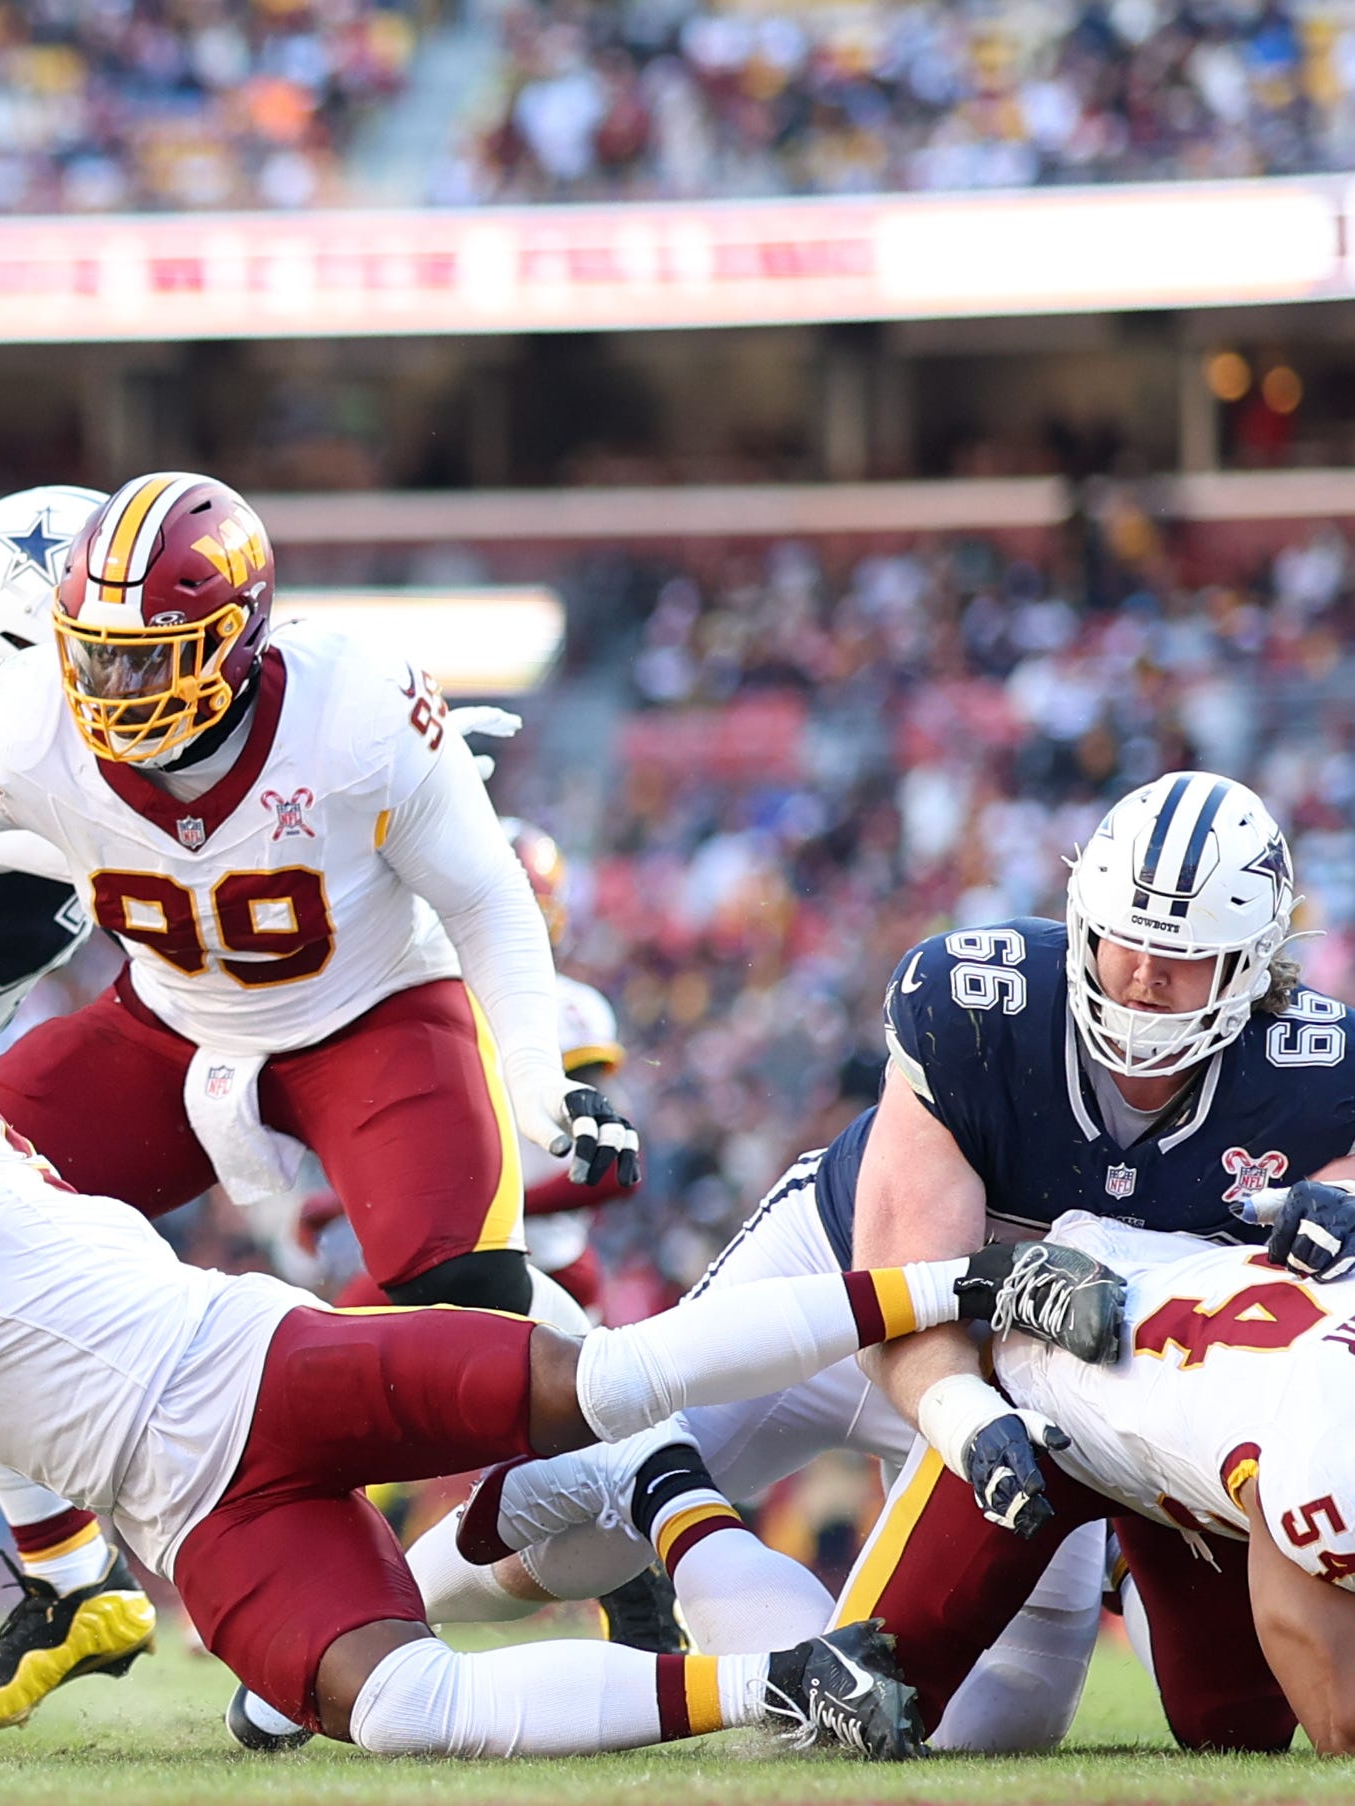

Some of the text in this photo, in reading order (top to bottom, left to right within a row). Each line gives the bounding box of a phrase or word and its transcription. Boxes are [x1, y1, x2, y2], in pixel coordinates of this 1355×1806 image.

[90, 864, 337, 989] 99
[1131, 914, 1181, 934] COWBOYS
[945, 928, 1027, 1015] 66
[1266, 990, 1346, 1068] 66
[1133, 1252, 1334, 1372] 4
[1280, 1493, 1355, 1584] 54
